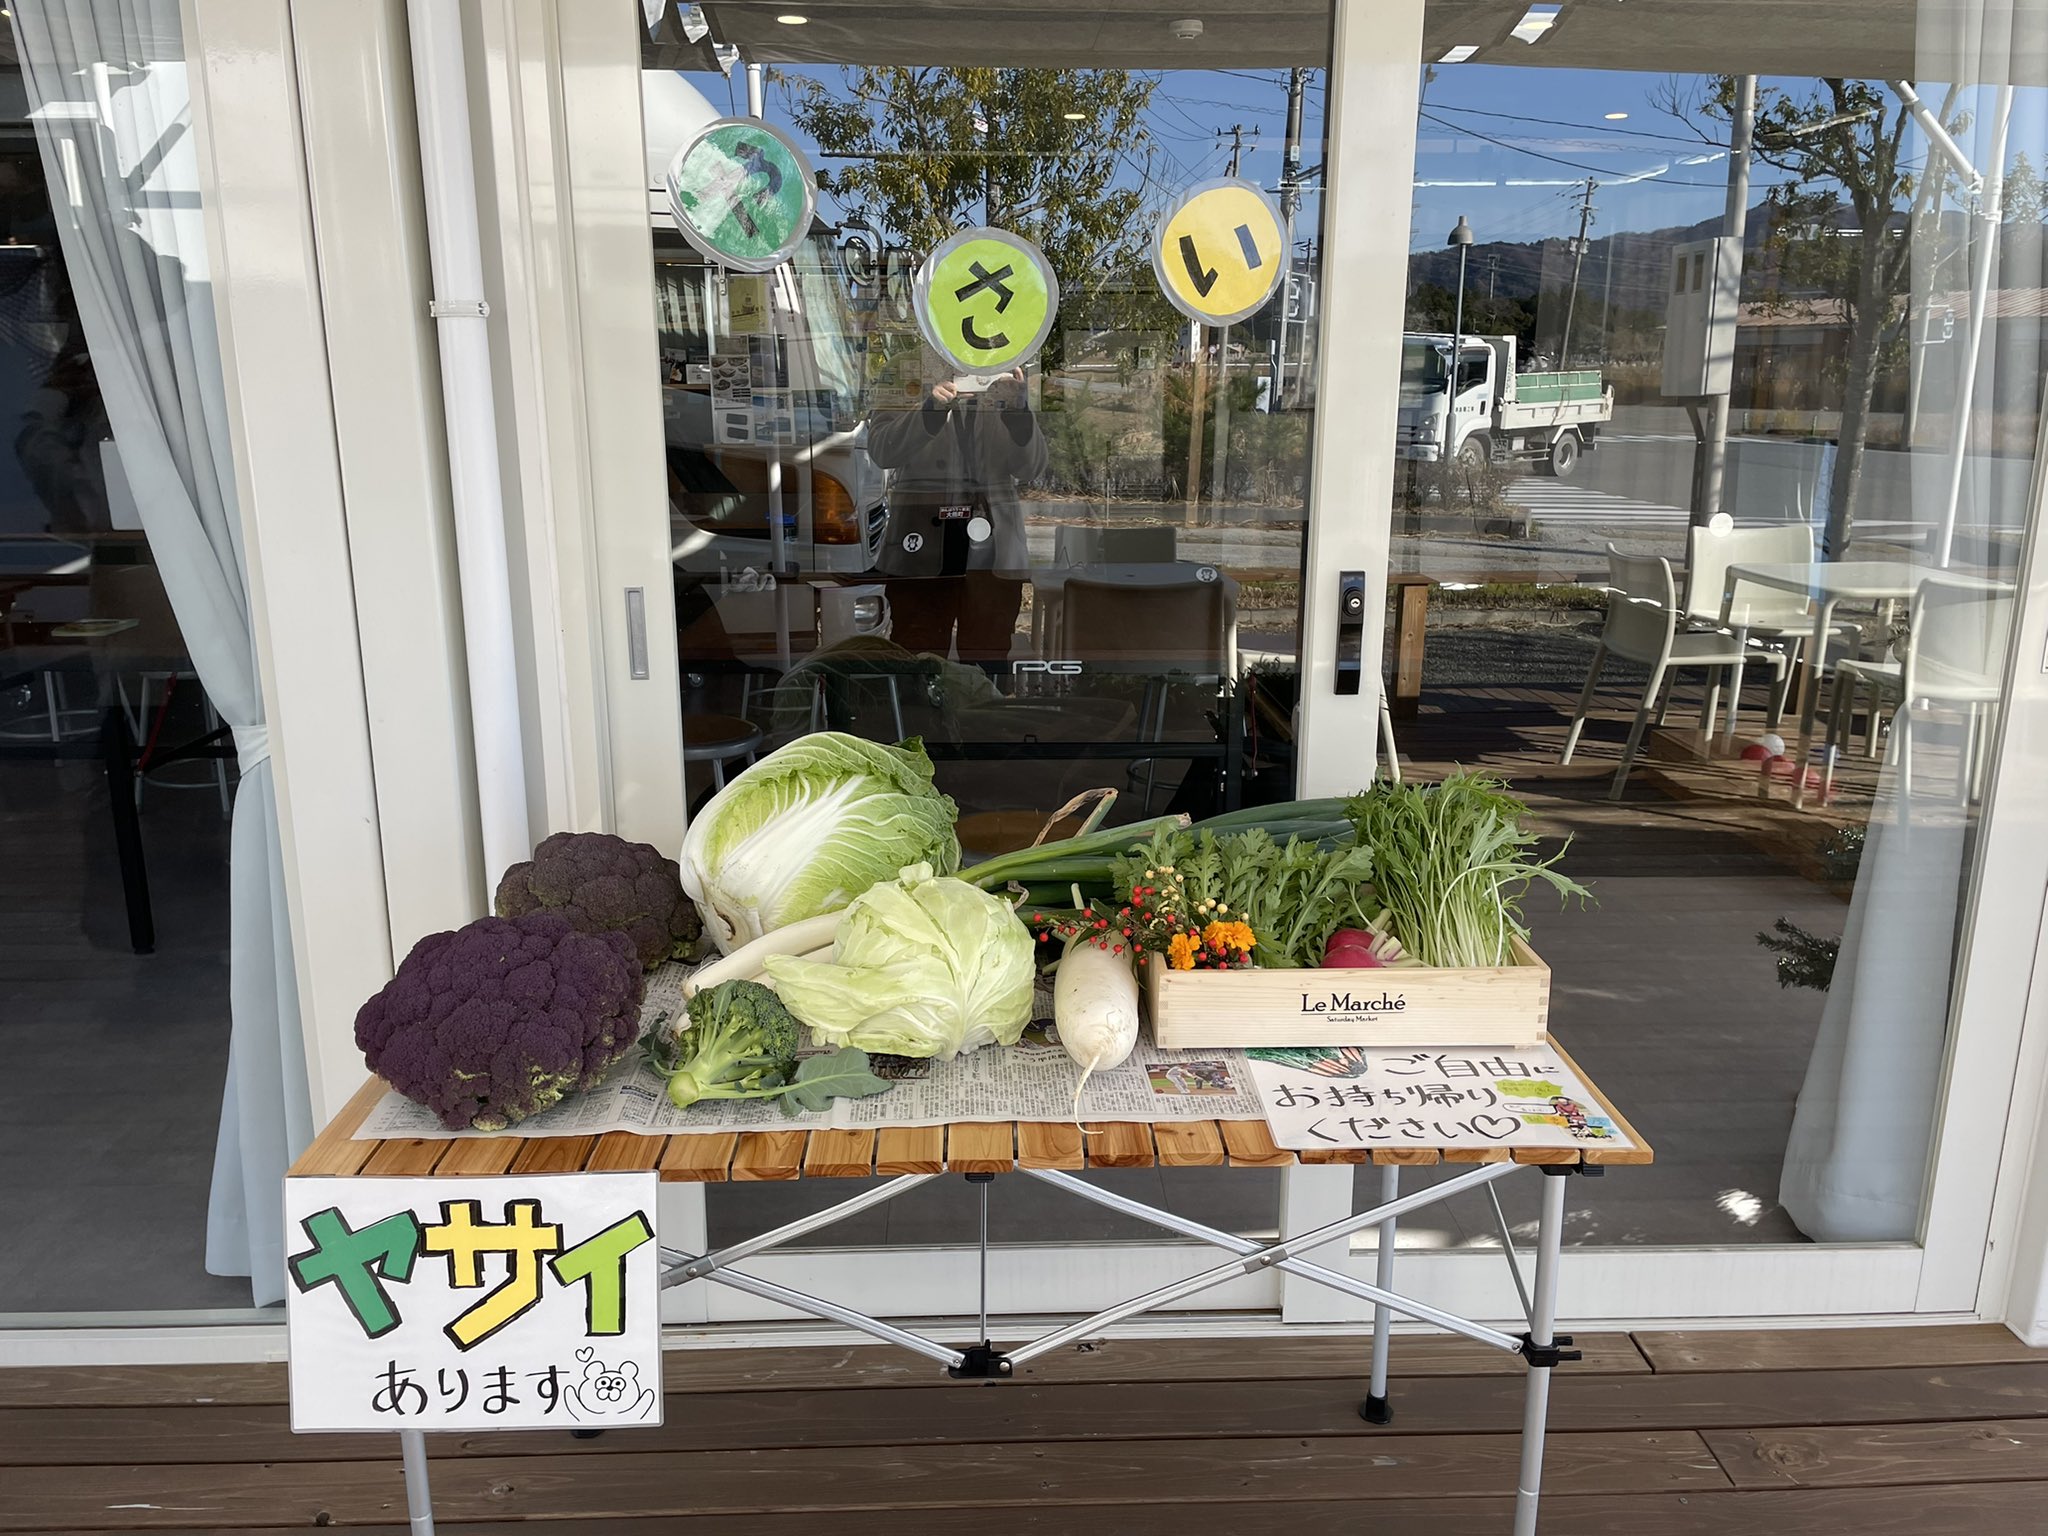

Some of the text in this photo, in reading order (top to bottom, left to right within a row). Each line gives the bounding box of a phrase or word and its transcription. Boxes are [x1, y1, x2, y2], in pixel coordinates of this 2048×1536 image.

[954, 260, 1015, 350] さ
[1178, 223, 1263, 298] い
[1301, 992, 1406, 1012] Le Marché
[1326, 1015, 1378, 1023] Saturday Market
[1382, 1053, 1561, 1079] ご自由に
[1271, 1083, 1498, 1109] お持ち帰り
[1306, 1116, 1475, 1142] ください
[288, 1198, 655, 1352] ヤサイ
[371, 1360, 571, 1416] あります
